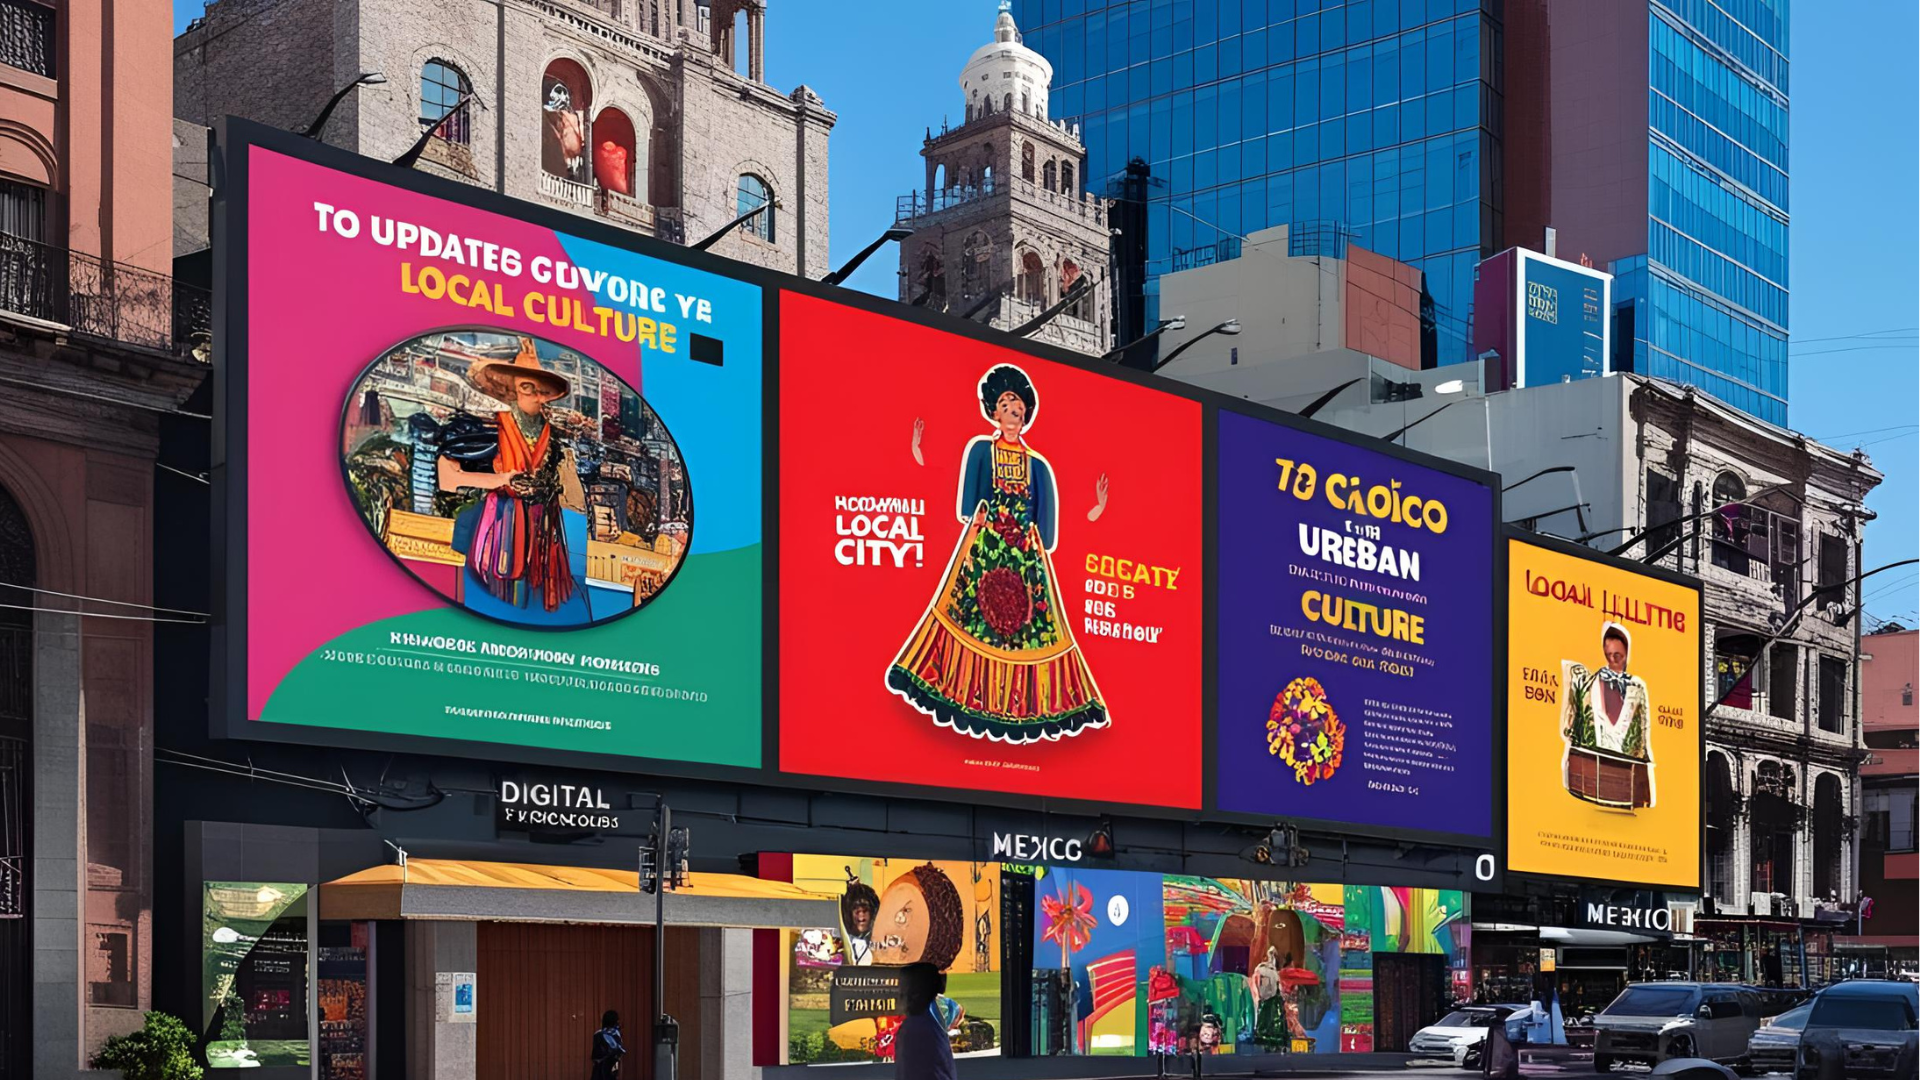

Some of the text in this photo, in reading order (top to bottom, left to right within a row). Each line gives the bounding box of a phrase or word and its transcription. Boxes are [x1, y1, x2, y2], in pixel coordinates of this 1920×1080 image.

[313, 201, 360, 239] TO
[401, 262, 678, 354] LOCAL CULTURE
[836, 514, 925, 541] LOCAL
[834, 538, 924, 568] CITY!
[1298, 522, 1421, 582] UREBAN
[501, 780, 611, 810] DIGITAL
